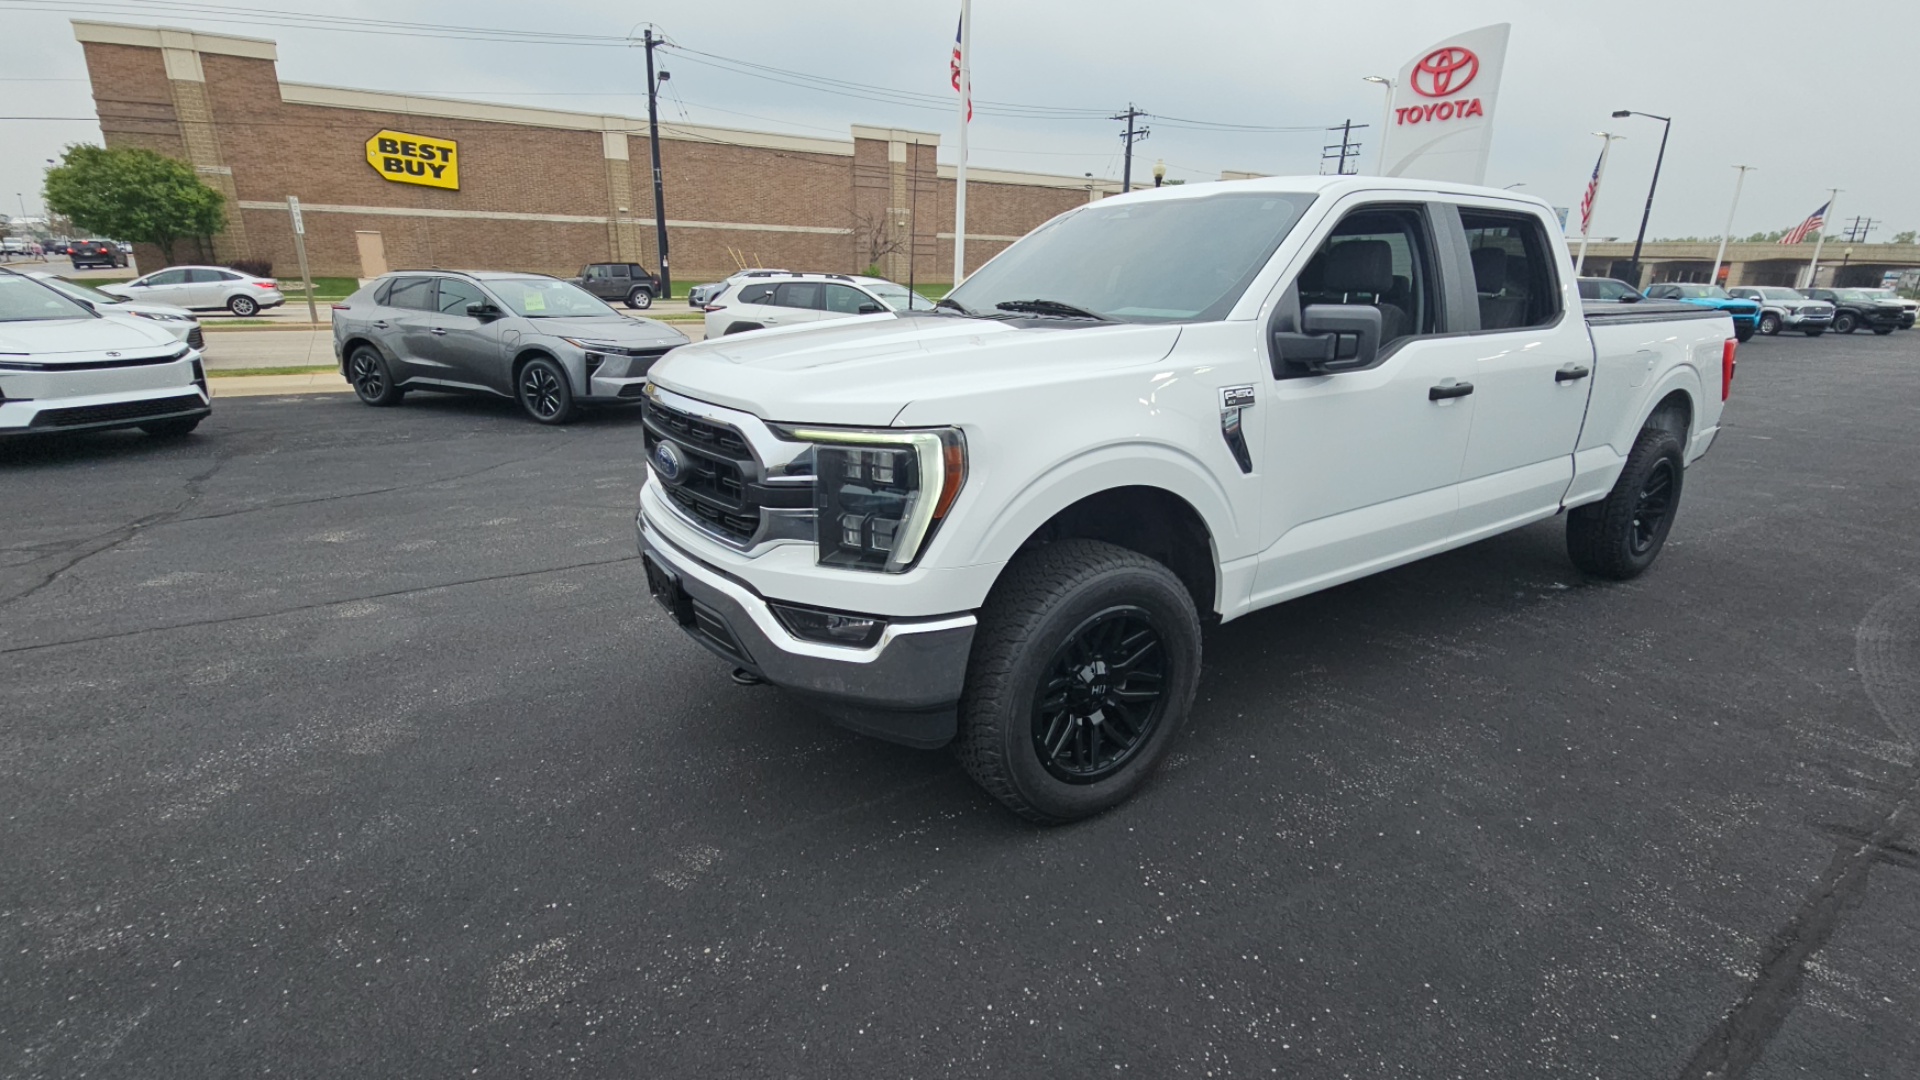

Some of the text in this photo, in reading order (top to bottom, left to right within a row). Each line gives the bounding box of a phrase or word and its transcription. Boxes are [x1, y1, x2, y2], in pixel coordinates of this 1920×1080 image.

[1395, 98, 1483, 125] TOYOTA
[378, 137, 453, 163] BEST
[383, 156, 447, 179] BUY
